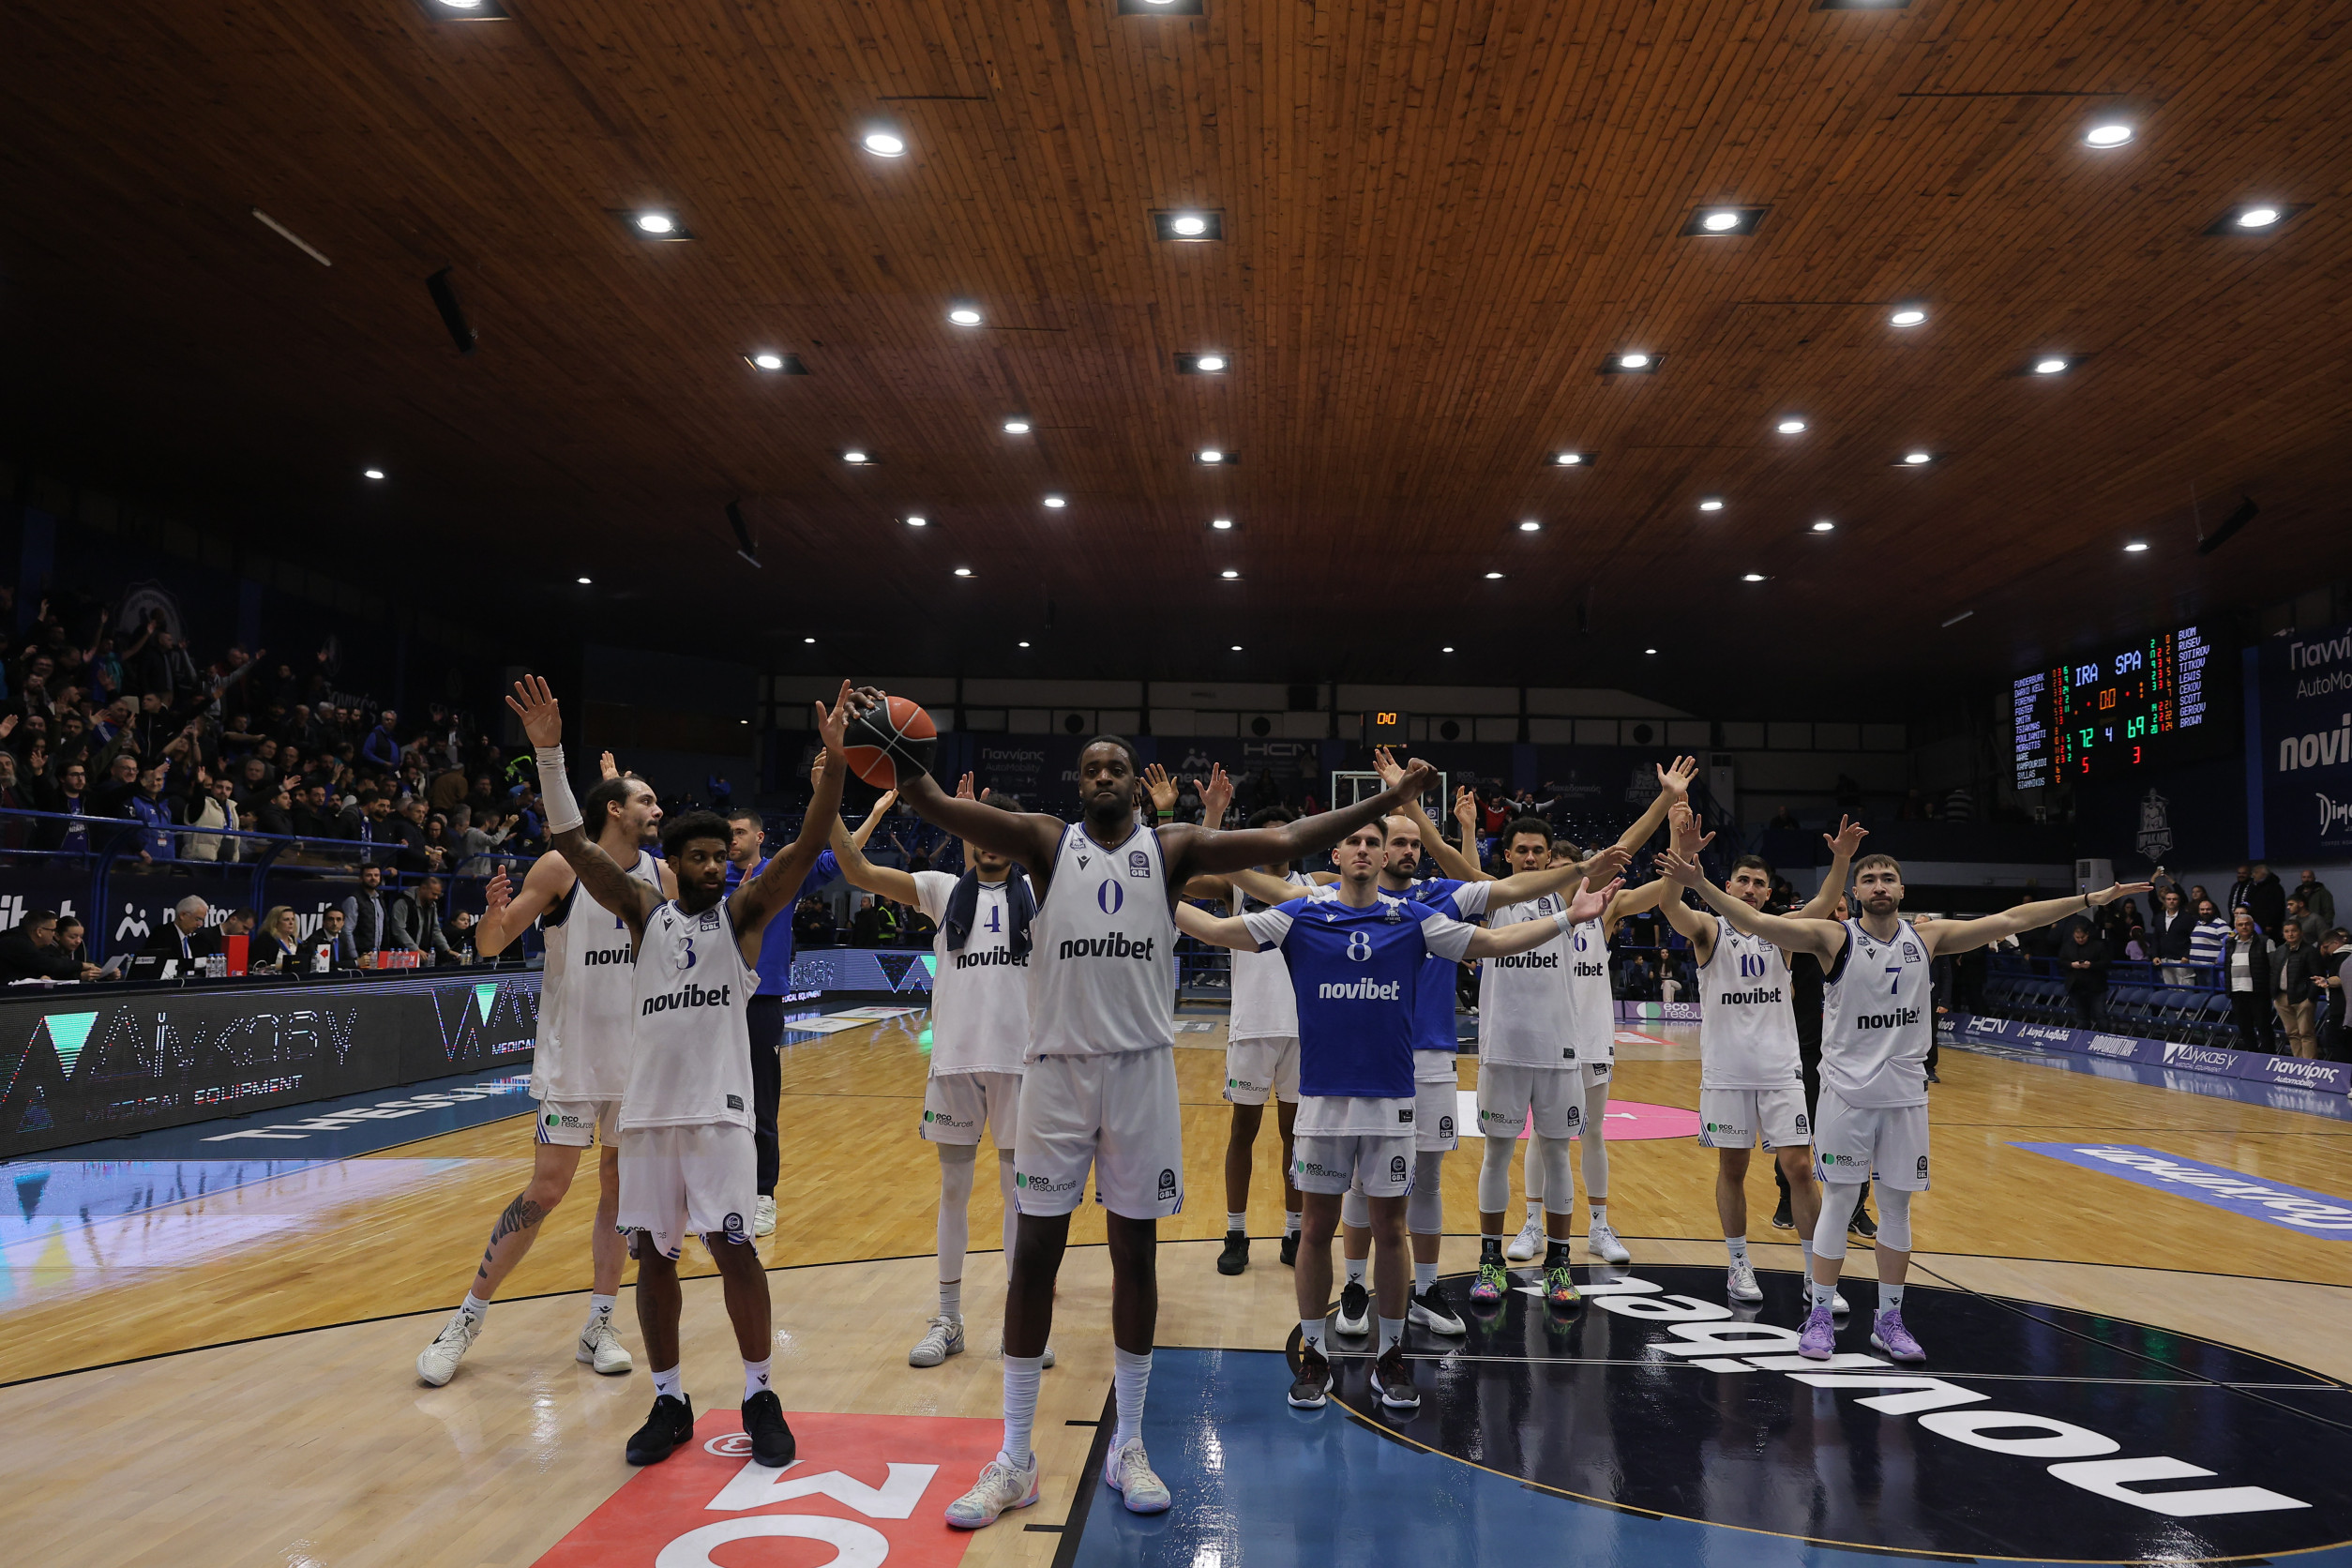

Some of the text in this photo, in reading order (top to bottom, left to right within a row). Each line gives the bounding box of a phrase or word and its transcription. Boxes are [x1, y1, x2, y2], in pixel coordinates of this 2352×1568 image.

[2179, 636, 2201, 652] RUSEV
[2179, 644, 2210, 662] SOTIROV
[2290, 626, 2352, 670] Γιαννί
[2075, 650, 2142, 686] IRA SPA
[2179, 657, 2206, 672] TITKOV
[2179, 692, 2202, 705] SCOTT
[2105, 727, 2113, 742] 4
[2127, 716, 2145, 739] 69
[2079, 728, 2093, 747] 72
[2280, 713, 2352, 772] novi
[982, 747, 1045, 762] Γιαννίρης
[2133, 746, 2141, 764] 3
[2082, 757, 2089, 774] 5
[1167, 770, 1212, 783] ment
[1097, 878, 1123, 915] 0
[701, 922, 719, 931] GBL
[983, 905, 1003, 933] 4
[1060, 931, 1154, 961] novibet
[1346, 930, 1373, 962] 8
[1574, 930, 1587, 952] 6
[585, 942, 636, 966] novi
[676, 938, 697, 970] 3
[1495, 951, 1559, 969] novibet
[1740, 953, 1766, 977] 10
[1319, 977, 1400, 1001] novibet
[1885, 966, 1903, 995] 7
[642, 983, 731, 1016] novibet
[1721, 987, 1782, 1005] novibet
[1663, 1003, 1690, 1011] eco
[1937, 1018, 1955, 1031] ino's
[1967, 1016, 2010, 1033] HCN
[2265, 1057, 2341, 1083] Γιαννίρης
[194, 1075, 303, 1106] EQUIPMENT
[2273, 1075, 2317, 1089] Automobility
[935, 1118, 973, 1128] resources
[1305, 1162, 1322, 1170] eco
[1305, 1168, 1347, 1179] resources
[1028, 1174, 1049, 1185] eco
[1029, 1180, 1077, 1192] resources
[1158, 1190, 1176, 1200] GBL
[1512, 1276, 2314, 1516] novibet
